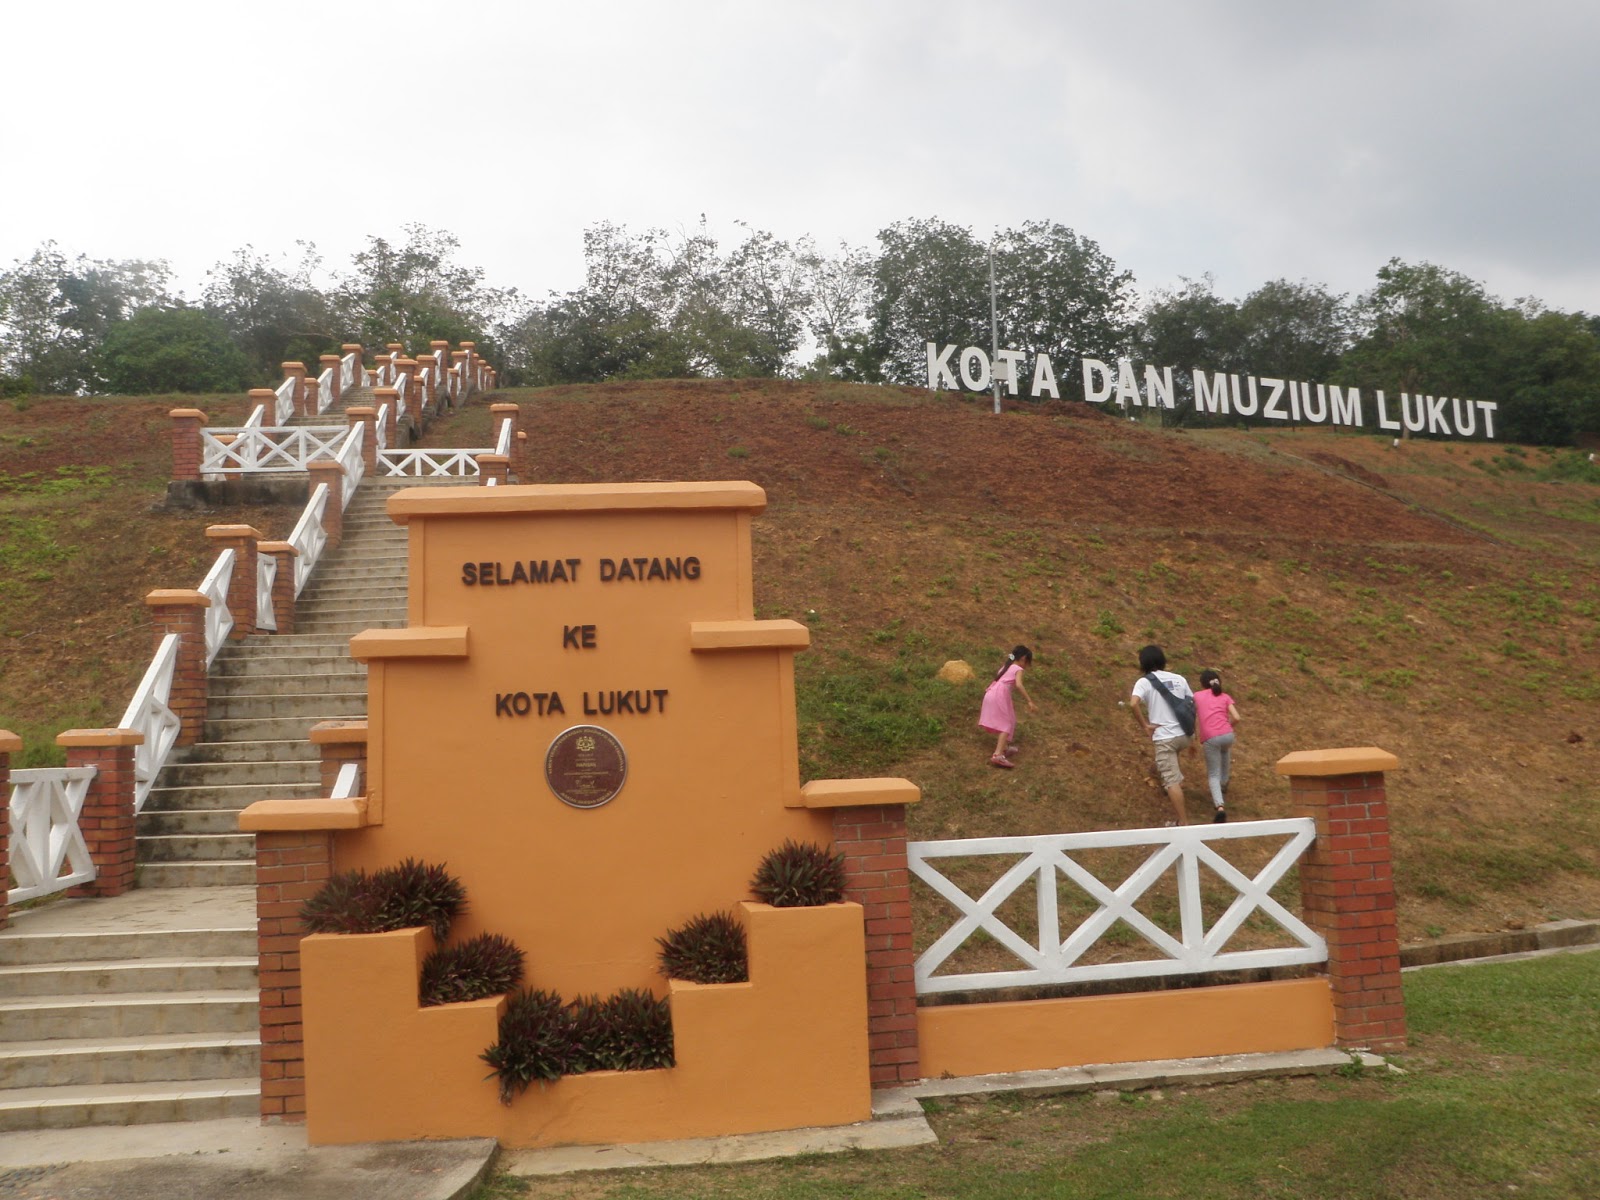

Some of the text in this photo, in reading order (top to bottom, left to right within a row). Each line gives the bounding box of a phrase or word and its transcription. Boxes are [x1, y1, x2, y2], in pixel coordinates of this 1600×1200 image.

[926, 342, 1498, 439] KOTA DAN MUZIUM LUKUT
[461, 556, 701, 586] SELAMAT DATANG
[563, 624, 597, 649] KE
[495, 689, 669, 717] KOTA LUKUT
